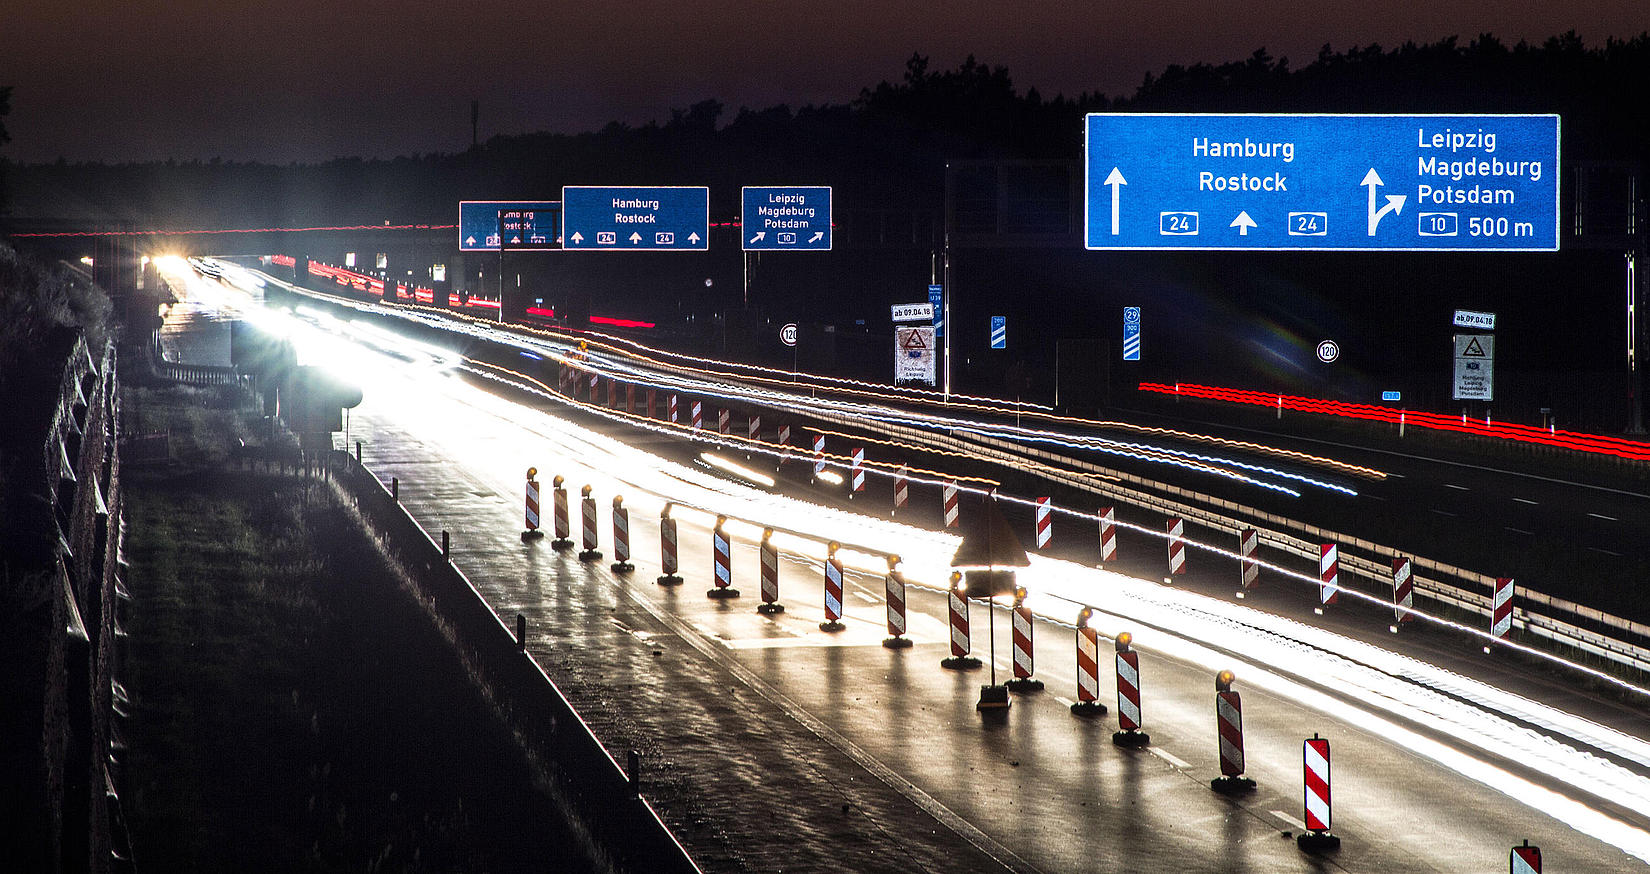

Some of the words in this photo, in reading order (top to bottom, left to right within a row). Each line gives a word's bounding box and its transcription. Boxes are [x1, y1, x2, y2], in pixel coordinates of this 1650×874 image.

[1417, 128, 1496, 153] Leipzig
[1192, 137, 1295, 162] Hamburg
[1417, 157, 1542, 182] Magdeburg
[1199, 171, 1287, 193] Rostock
[769, 193, 804, 205] Leipzig
[1417, 185, 1515, 205] Potsdam
[612, 198, 659, 210] Hamburg
[615, 213, 656, 224] Rostock
[758, 206, 815, 218] Magdeburg
[764, 218, 809, 228] Potsdam
[1169, 217, 1189, 231] 24
[1298, 217, 1318, 231] 24
[1430, 217, 1446, 231] 10
[1468, 217, 1508, 237] 500
[1514, 222, 1534, 237] m
[1127, 311, 1138, 319] 29
[1322, 346, 1335, 357] 120
